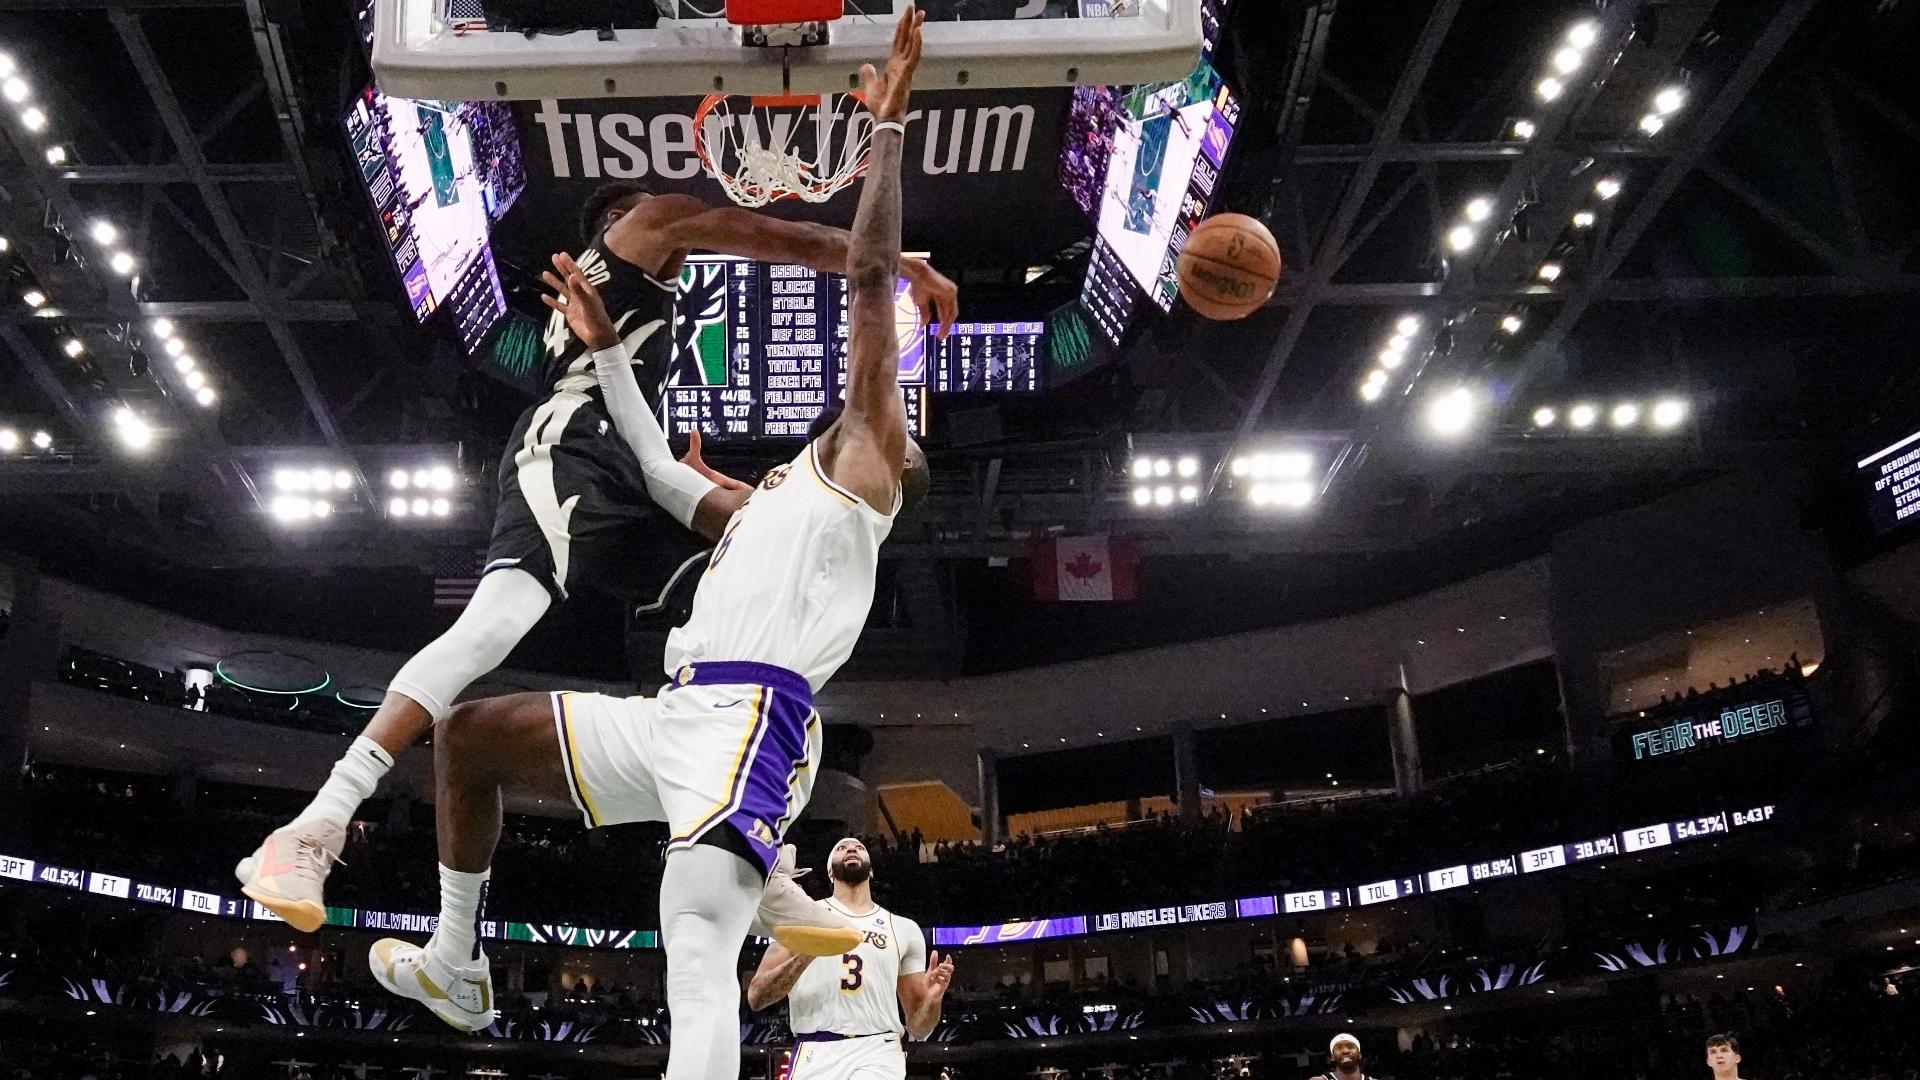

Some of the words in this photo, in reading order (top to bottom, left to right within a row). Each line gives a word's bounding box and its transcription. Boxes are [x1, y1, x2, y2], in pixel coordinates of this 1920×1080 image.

[1086, 3, 1109, 17] NBA
[770, 265, 817, 278] ASSISTS
[738, 280, 746, 293] 4
[772, 281, 815, 294] BLOCKS
[738, 295, 746, 308] 2
[772, 297, 815, 310] STEALS
[738, 311, 746, 324] 9
[771, 312, 792, 325] OFF
[795, 312, 817, 325] REB
[736, 327, 750, 339] 25
[772, 329, 792, 341] DEF
[795, 329, 817, 341] REB
[958, 323, 974, 334] PTS
[980, 323, 996, 334] REB
[1002, 323, 1018, 334] AST
[960, 336, 971, 346] 34
[985, 335, 992, 346] 5
[1007, 335, 1014, 345] 3
[1029, 335, 1036, 345] 2
[737, 342, 750, 355] 10
[765, 344, 824, 357] TURNOVERS
[940, 347, 947, 358] 4
[961, 347, 971, 357] 14
[985, 347, 992, 357] 2
[1030, 346, 1035, 356] 1
[737, 358, 750, 371] 13
[768, 360, 800, 372] TOTAL
[801, 360, 822, 372] FLS
[985, 358, 992, 368] 7
[1030, 358, 1035, 368] 1
[736, 374, 750, 386] 20
[768, 376, 800, 388] BENCH
[801, 376, 822, 388] PTS
[939, 370, 948, 380] 15
[962, 370, 969, 380] 7
[985, 369, 992, 380] 2
[1007, 369, 1012, 380] 1
[939, 381, 948, 391] 21
[962, 381, 969, 391] 7
[985, 381, 992, 391] 3
[1006, 381, 1013, 391] 2
[1028, 381, 1036, 391] 2
[675, 390, 698, 403] 55.0
[702, 390, 711, 402] %
[765, 391, 792, 404] FIELD
[794, 391, 825, 404] GOALS
[676, 406, 698, 418] 40.5
[702, 406, 711, 418] %
[723, 405, 750, 417] 15/37
[766, 406, 823, 419] 3-POINTERS
[702, 421, 711, 433] %
[727, 420, 748, 433] 7/10
[765, 421, 788, 435] FREE
[789, 421, 810, 435] THR
[1880, 447, 1920, 475] REBOUND
[1874, 475, 1892, 491] OFF
[1892, 461, 1920, 482] REBOU
[1891, 473, 1920, 496] BLOCK
[1895, 488, 1920, 508] STEAL
[1896, 500, 1920, 520] ASSIS
[1632, 721, 1695, 760] FEAR
[1692, 720, 1722, 740] THE
[1720, 700, 1787, 739] DEER
[1293, 894, 1317, 909] FLS
[1331, 891, 1341, 906] 2
[1368, 884, 1390, 900] TOL
[1403, 879, 1413, 894] 3
[1441, 871, 1456, 886] FT
[1472, 858, 1513, 880] 88.9%
[1532, 849, 1556, 868] 3PT
[1574, 836, 1614, 860] 38.1%
[1638, 830, 1656, 846] FG
[1676, 815, 1724, 839] 54.3%
[1732, 807, 1764, 826] 8:43
[1, 859, 25, 876] 3PT
[40, 866, 80, 887] 40.5%
[101, 878, 117, 893] FT
[136, 883, 172, 904] 70.0%
[191, 894, 212, 910] TOL
[227, 900, 236, 915] 3
[261, 905, 276, 917] FL
[365, 910, 439, 933] MILWAUKE
[1095, 913, 1120, 932] LOS
[1121, 907, 1176, 929] ANGELES
[1177, 901, 1227, 923] LAKERS
[840, 953, 864, 991] 3
